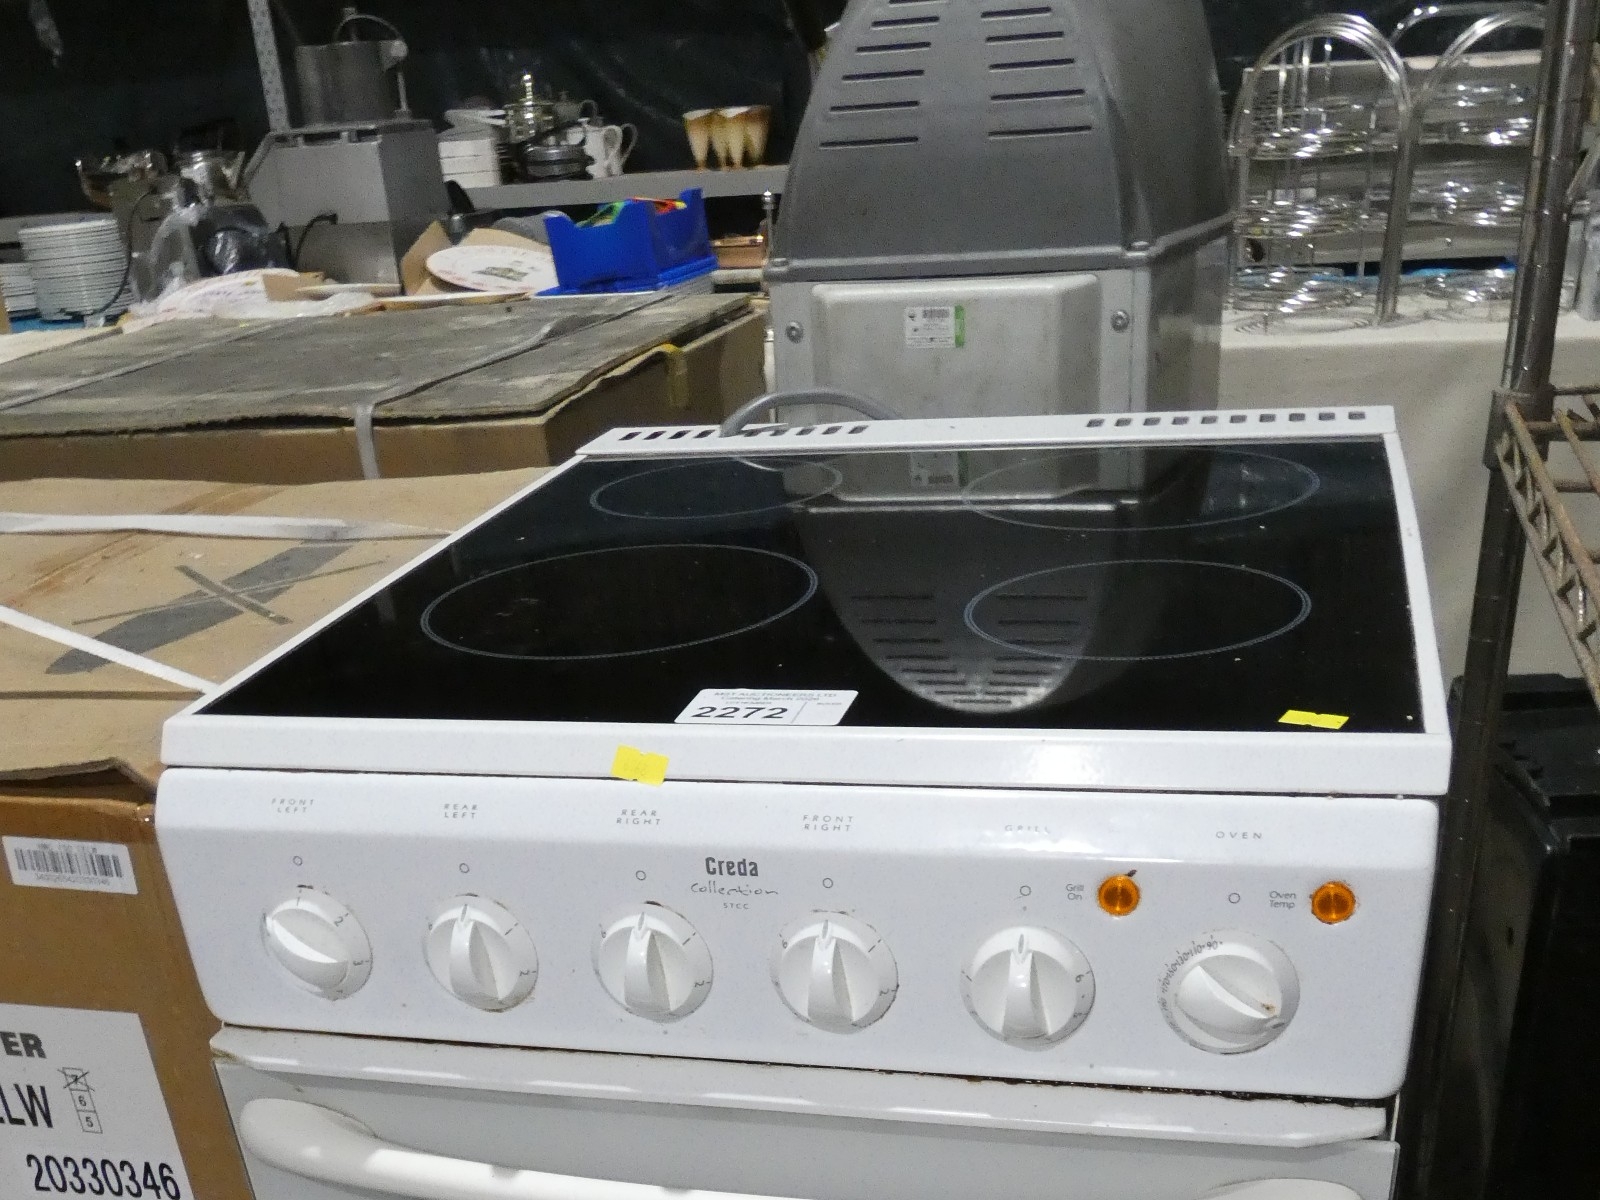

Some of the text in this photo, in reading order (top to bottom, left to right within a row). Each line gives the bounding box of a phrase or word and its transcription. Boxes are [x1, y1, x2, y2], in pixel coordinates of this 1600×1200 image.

[692, 706, 788, 719] 2272
[272, 798, 314, 807] FRONT
[444, 803, 478, 811] REAR
[277, 806, 307, 814] LEFT
[621, 809, 657, 817] REAR
[616, 817, 661, 826] RIGHT
[803, 814, 854, 823] FRONT
[804, 823, 851, 832] RIGHT
[1004, 824, 1050, 834] GRILL
[1216, 831, 1263, 840] OVEN
[705, 856, 759, 877] Creda
[690, 880, 779, 897] Collection
[1065, 883, 1085, 893] Grill
[1067, 892, 1082, 902] On
[1269, 890, 1297, 901] Oven
[1269, 899, 1296, 910] Temp
[0, 1031, 47, 1059] ER
[78, 1095, 88, 1107] 6
[85, 1116, 95, 1128] 5
[26, 1154, 181, 1200] 20330346
